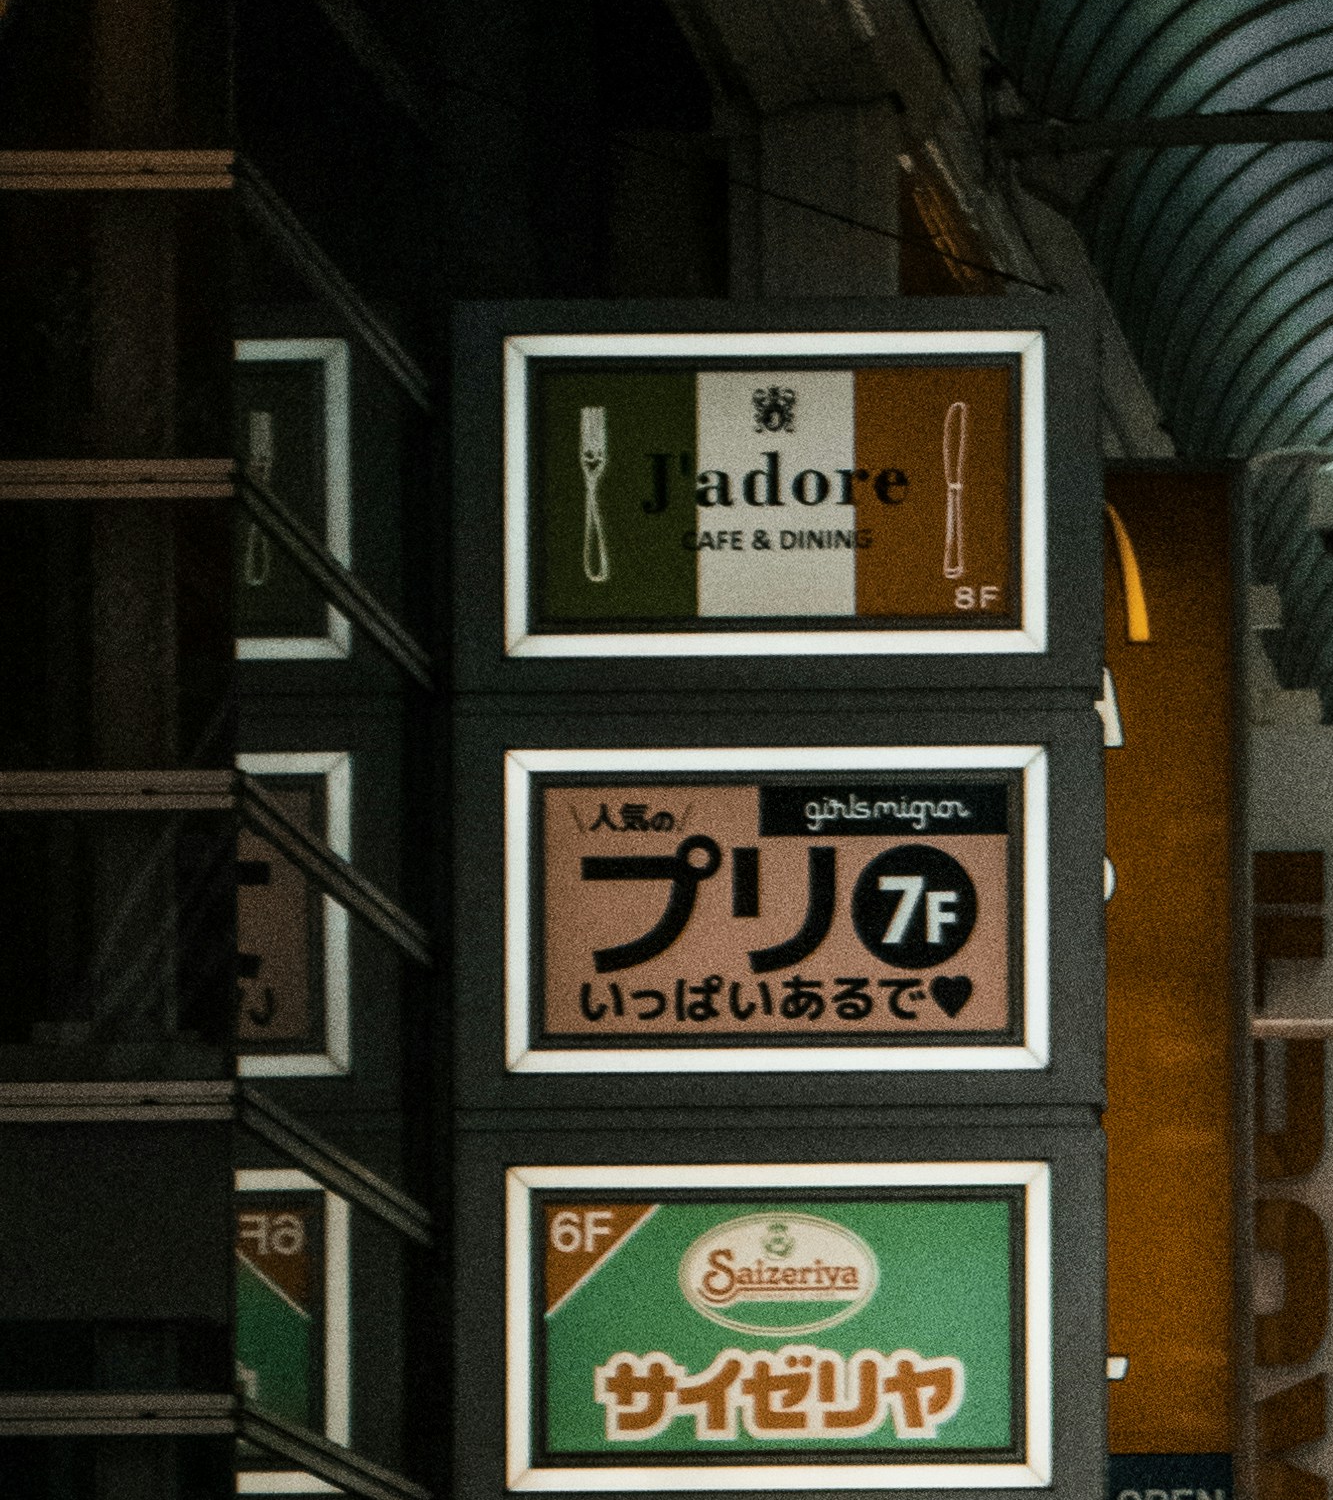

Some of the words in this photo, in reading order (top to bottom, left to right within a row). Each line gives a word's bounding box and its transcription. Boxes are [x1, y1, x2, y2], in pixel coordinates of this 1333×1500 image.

[643, 450, 910, 516] J'adore
[682, 529, 743, 551] CAFE
[752, 529, 771, 551] &
[780, 529, 873, 551] DINING
[954, 585, 999, 609] 8F
[592, 802, 676, 833] 人気の
[581, 834, 836, 973] プリ
[878, 876, 958, 945] 7F
[580, 974, 927, 1021] いっぱいあるで
[549, 1211, 611, 1253] 6F
[700, 1248, 860, 1297] Saizeriya
[601, 1349, 960, 1436] サイゼリヤ
